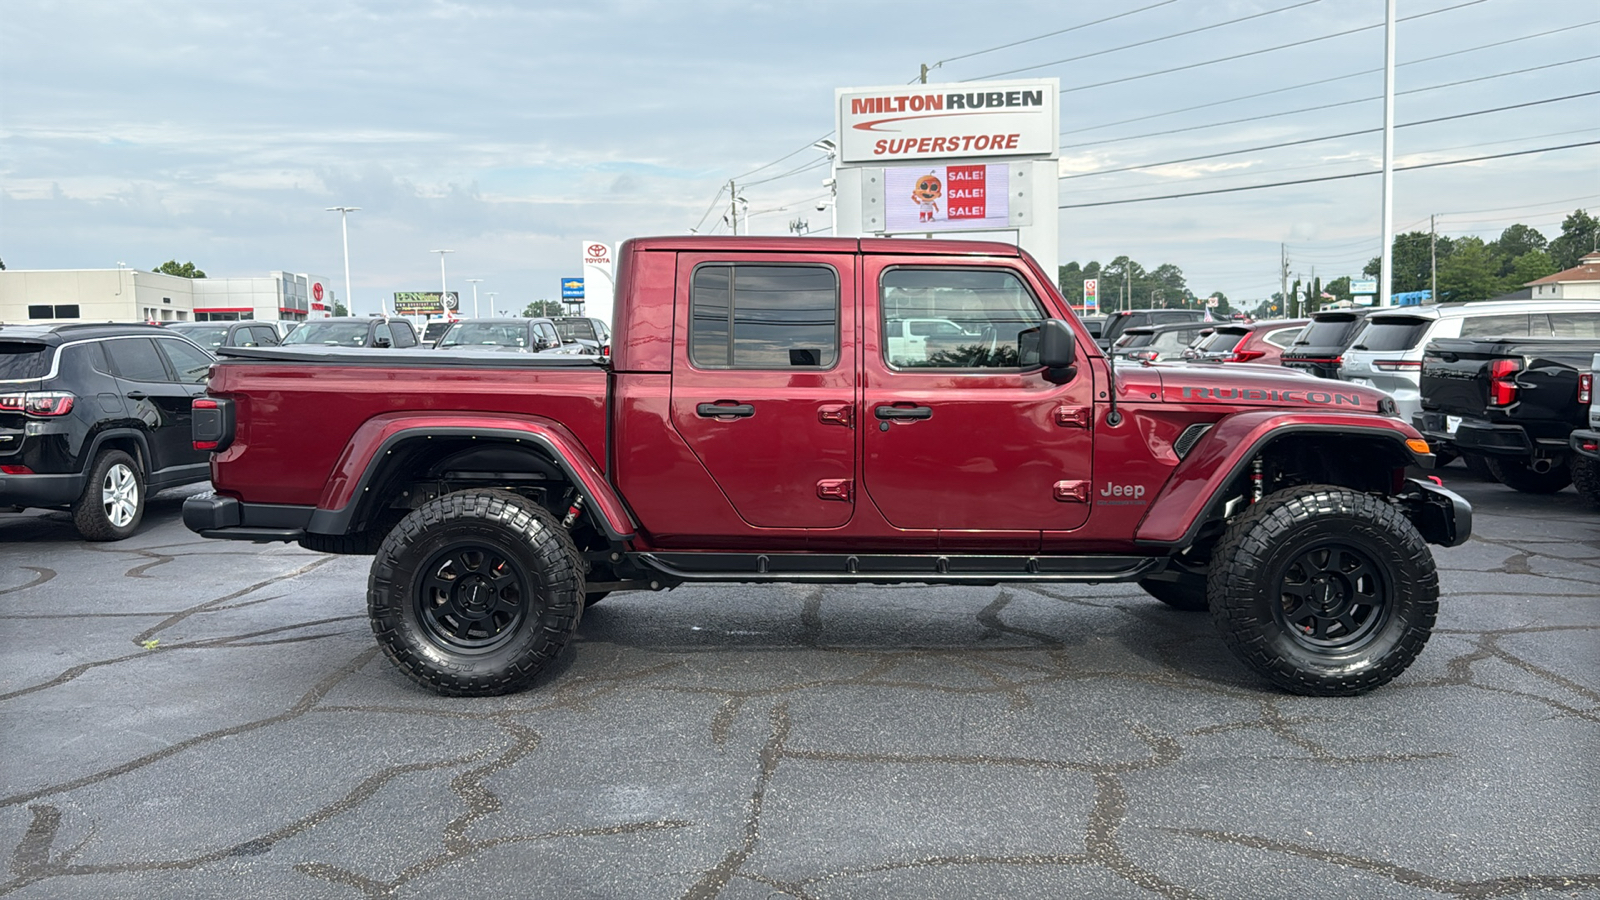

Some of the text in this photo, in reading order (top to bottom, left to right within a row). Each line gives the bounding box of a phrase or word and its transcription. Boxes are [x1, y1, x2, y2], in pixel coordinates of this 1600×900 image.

[851, 90, 1043, 115] MILTON RUBEN
[873, 133, 1021, 155] SUPERSTORE
[948, 170, 984, 181] SALE!
[948, 188, 984, 199] SALE!
[948, 206, 984, 217] SALE!
[1182, 386, 1361, 406] RUBICON
[1100, 481, 1145, 499] Jeep
